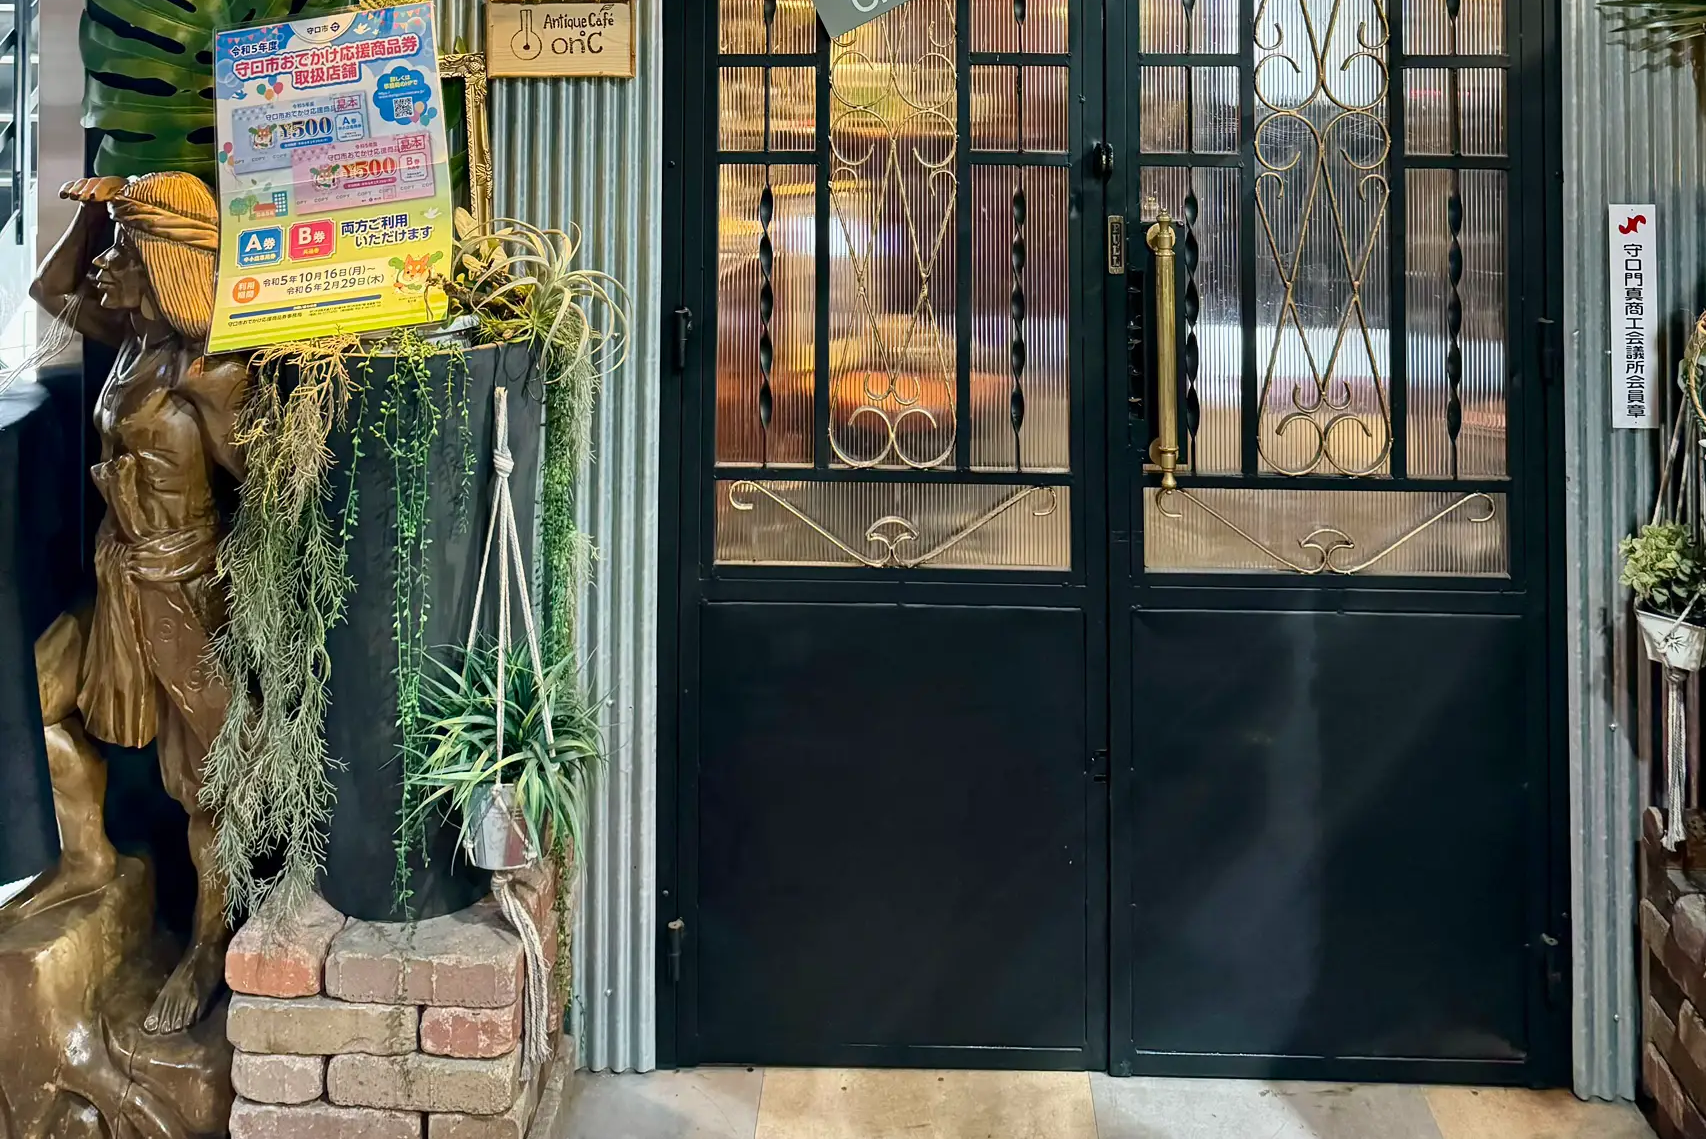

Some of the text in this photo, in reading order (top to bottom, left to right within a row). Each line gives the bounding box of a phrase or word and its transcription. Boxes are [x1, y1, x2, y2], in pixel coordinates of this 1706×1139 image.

[306, 24, 329, 35] 守口市
[543, 11, 615, 30] Antique Café
[230, 41, 279, 57] 令和5年度
[235, 35, 418, 78] 守口市おでかけ応援商品券
[294, 63, 358, 86] 取扱店舗
[341, 213, 408, 236] 両方ご利用
[355, 225, 433, 247] いただけます
[1111, 223, 1121, 268] PULL
[237, 281, 256, 291] 利用
[1623, 243, 1646, 418] 守口門真商工会議所会員章
